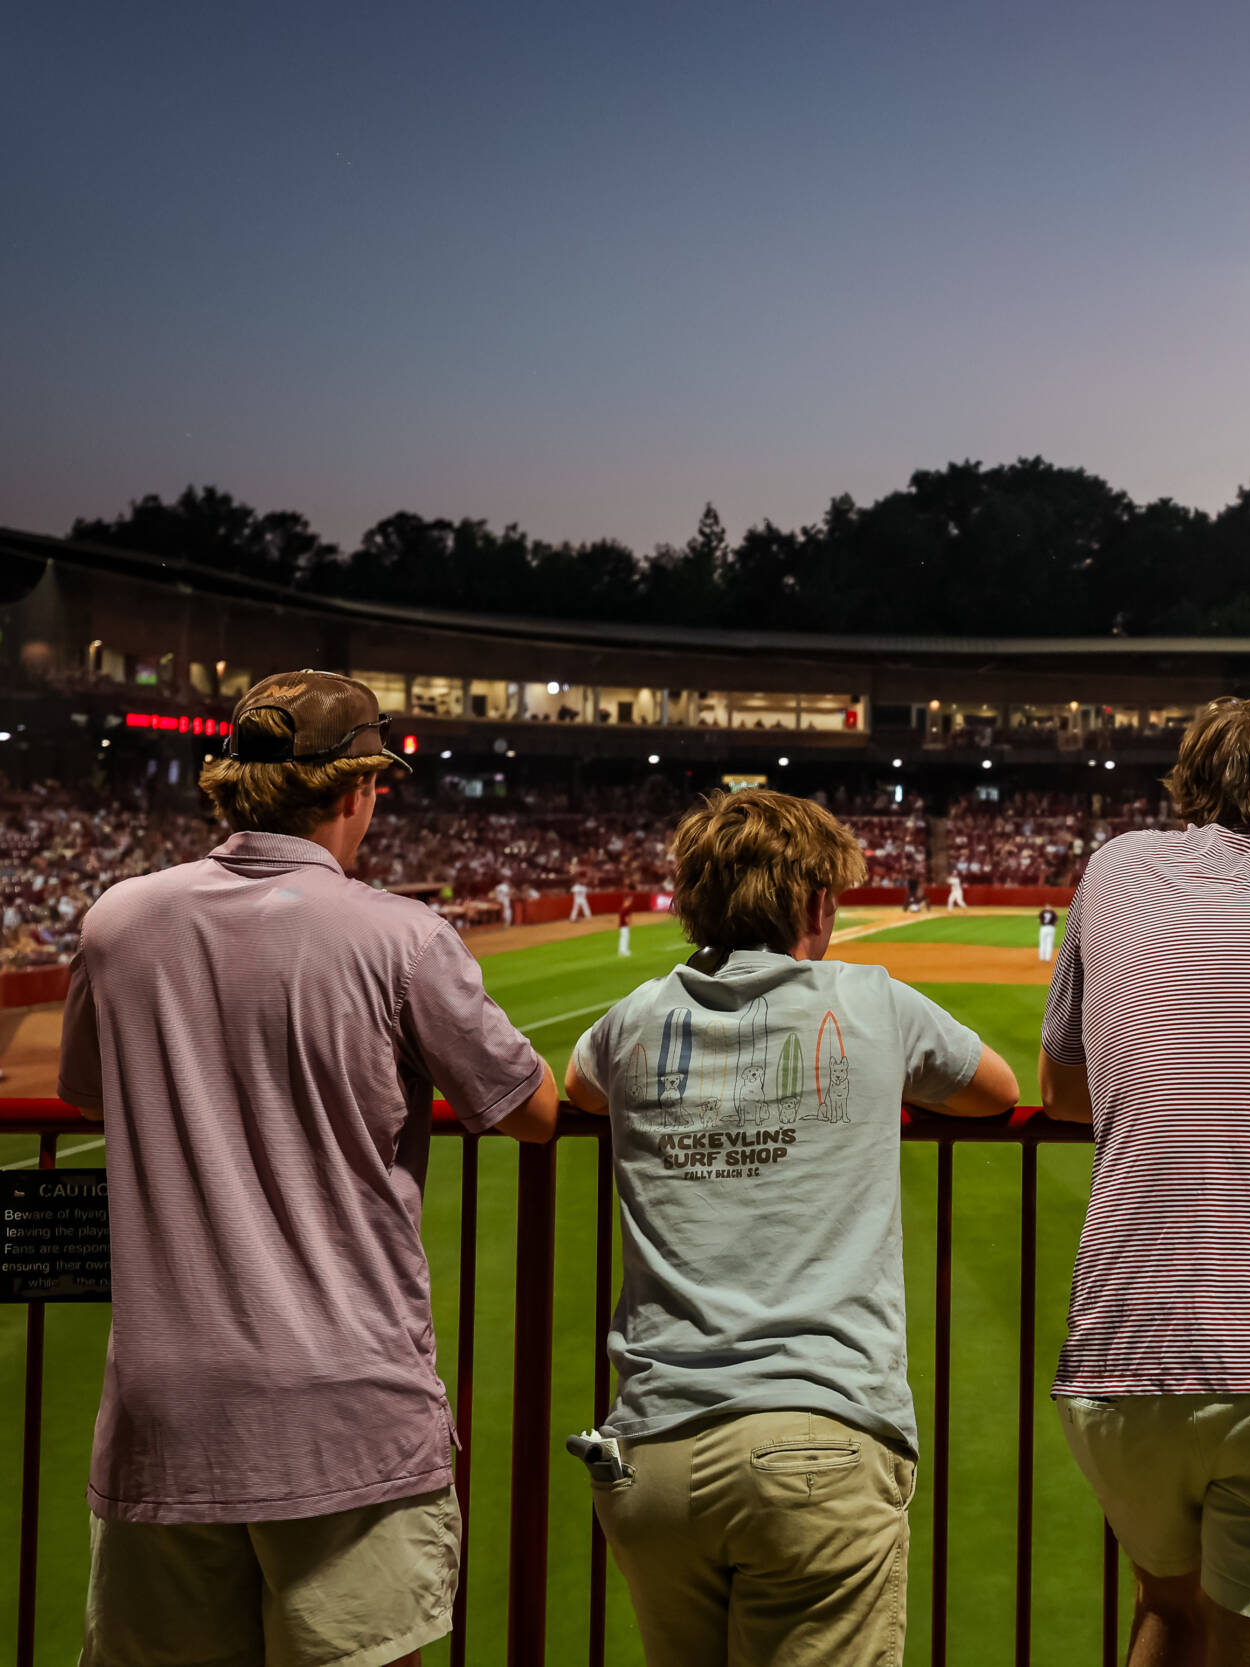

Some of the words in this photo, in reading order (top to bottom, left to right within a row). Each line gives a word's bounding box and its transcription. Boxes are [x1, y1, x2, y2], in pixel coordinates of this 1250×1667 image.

[663, 1151, 722, 1170] SURF
[725, 1147, 788, 1167] SHOP
[684, 1170, 713, 1181] FOLLY
[715, 1168, 743, 1179] BEACH
[39, 1183, 108, 1197] CAUTIO
[4, 1209, 55, 1221] Beware
[57, 1207, 70, 1219] of
[74, 1208, 107, 1222] flying
[6, 1226, 51, 1239] leaving
[55, 1225, 74, 1236] the
[78, 1225, 110, 1239] playi
[4, 1243, 36, 1255] Fans
[39, 1245, 60, 1255] are
[63, 1244, 110, 1256] respon
[2, 1262, 51, 1274] ensuring
[56, 1260, 82, 1272] their
